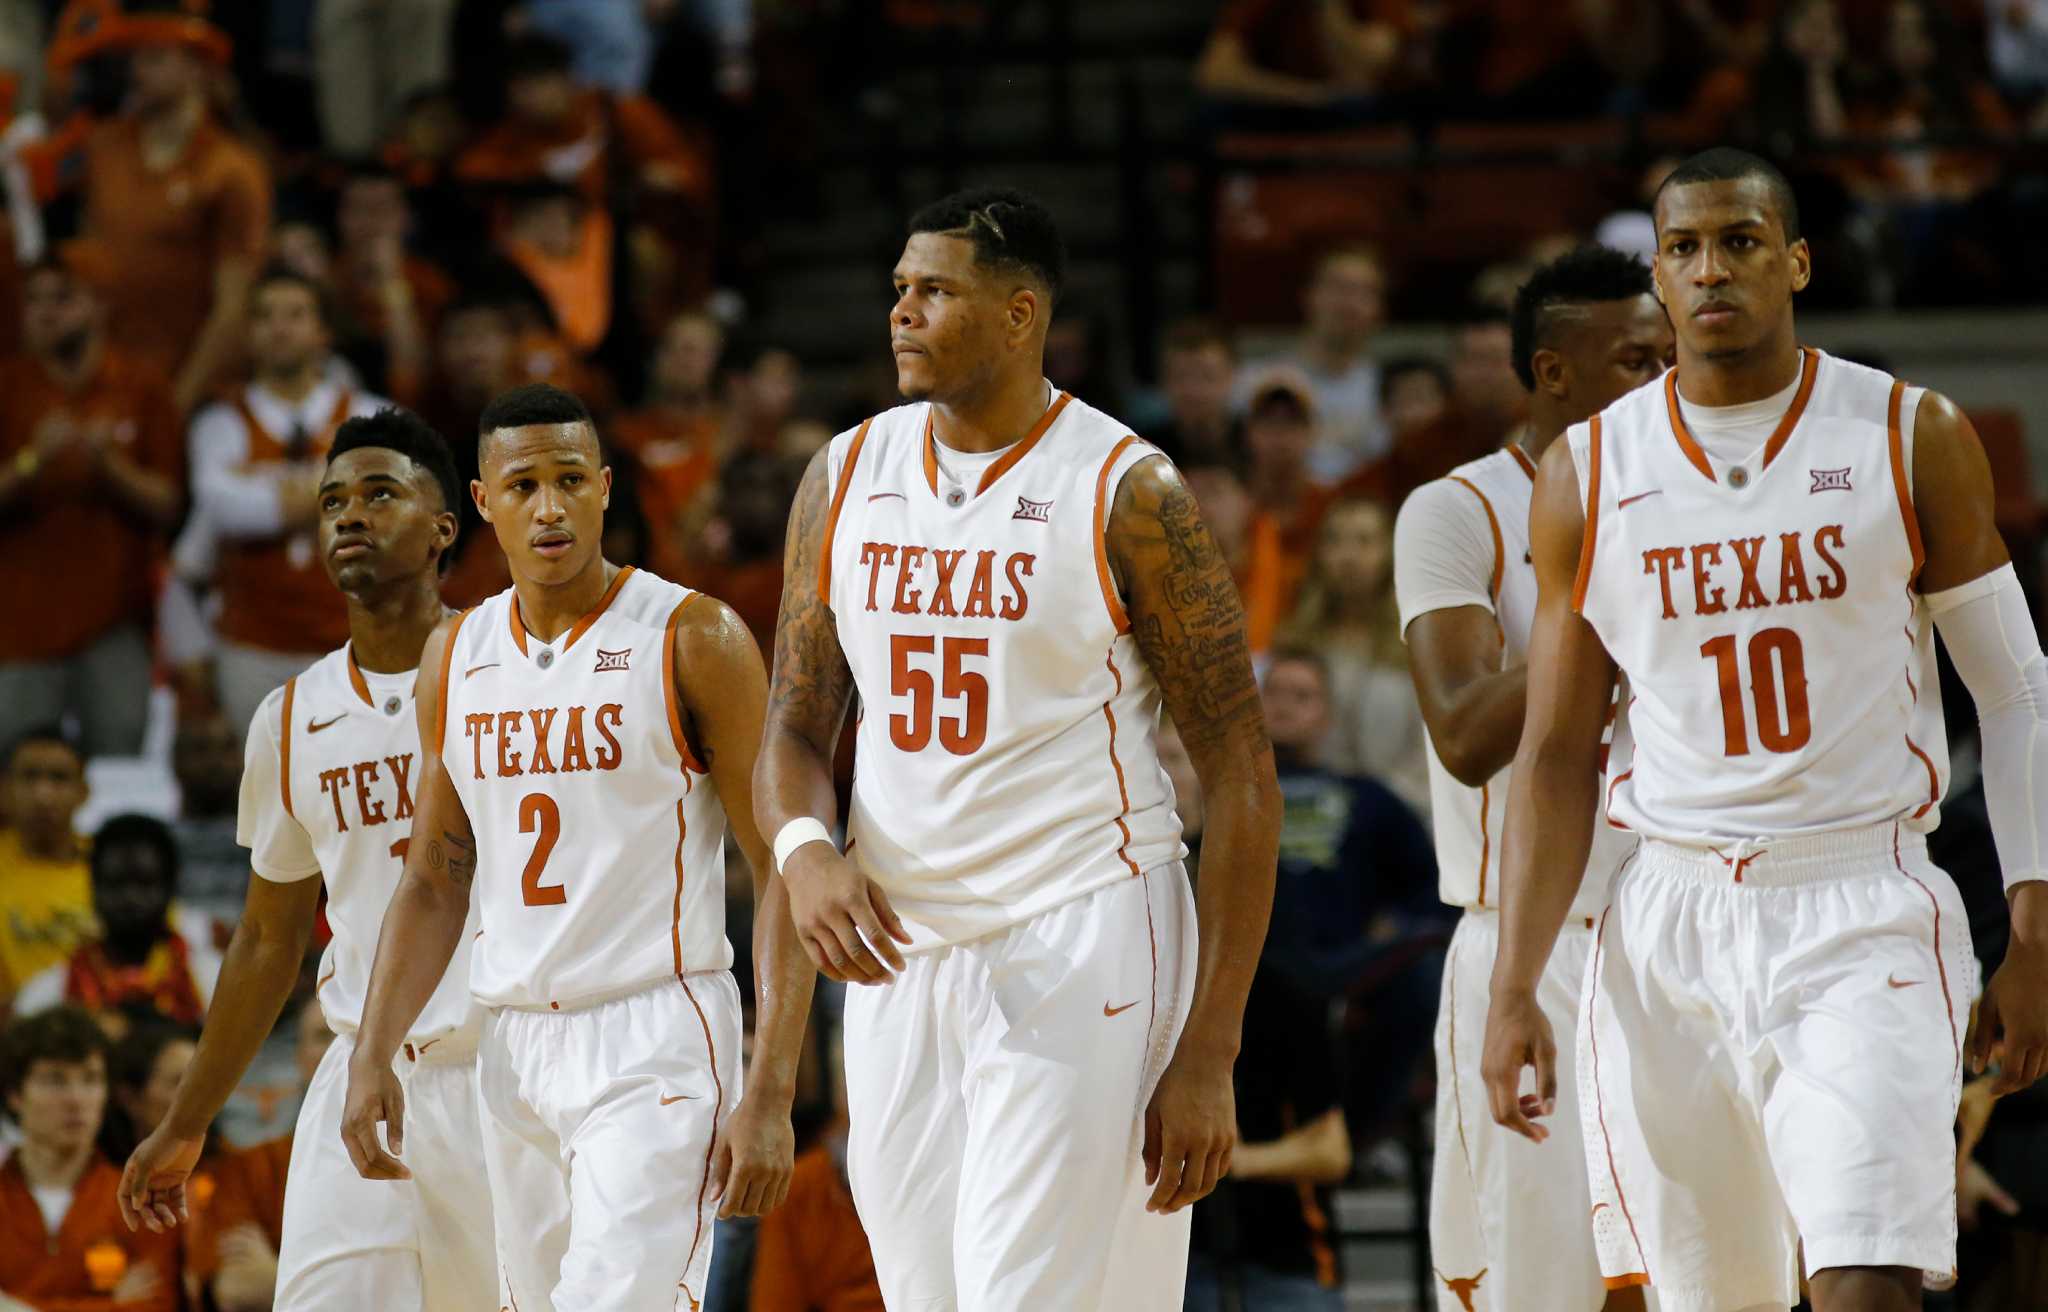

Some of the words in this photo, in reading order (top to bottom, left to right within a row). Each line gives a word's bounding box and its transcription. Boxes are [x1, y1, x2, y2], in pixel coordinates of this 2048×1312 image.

[859, 542, 1036, 621] TEXAS
[1642, 524, 1846, 620] TEXAS
[889, 634, 989, 756] 55
[1700, 627, 1811, 757] 10
[465, 703, 623, 780] TEXAS
[319, 752, 414, 833] TEX
[518, 792, 567, 907] 2
